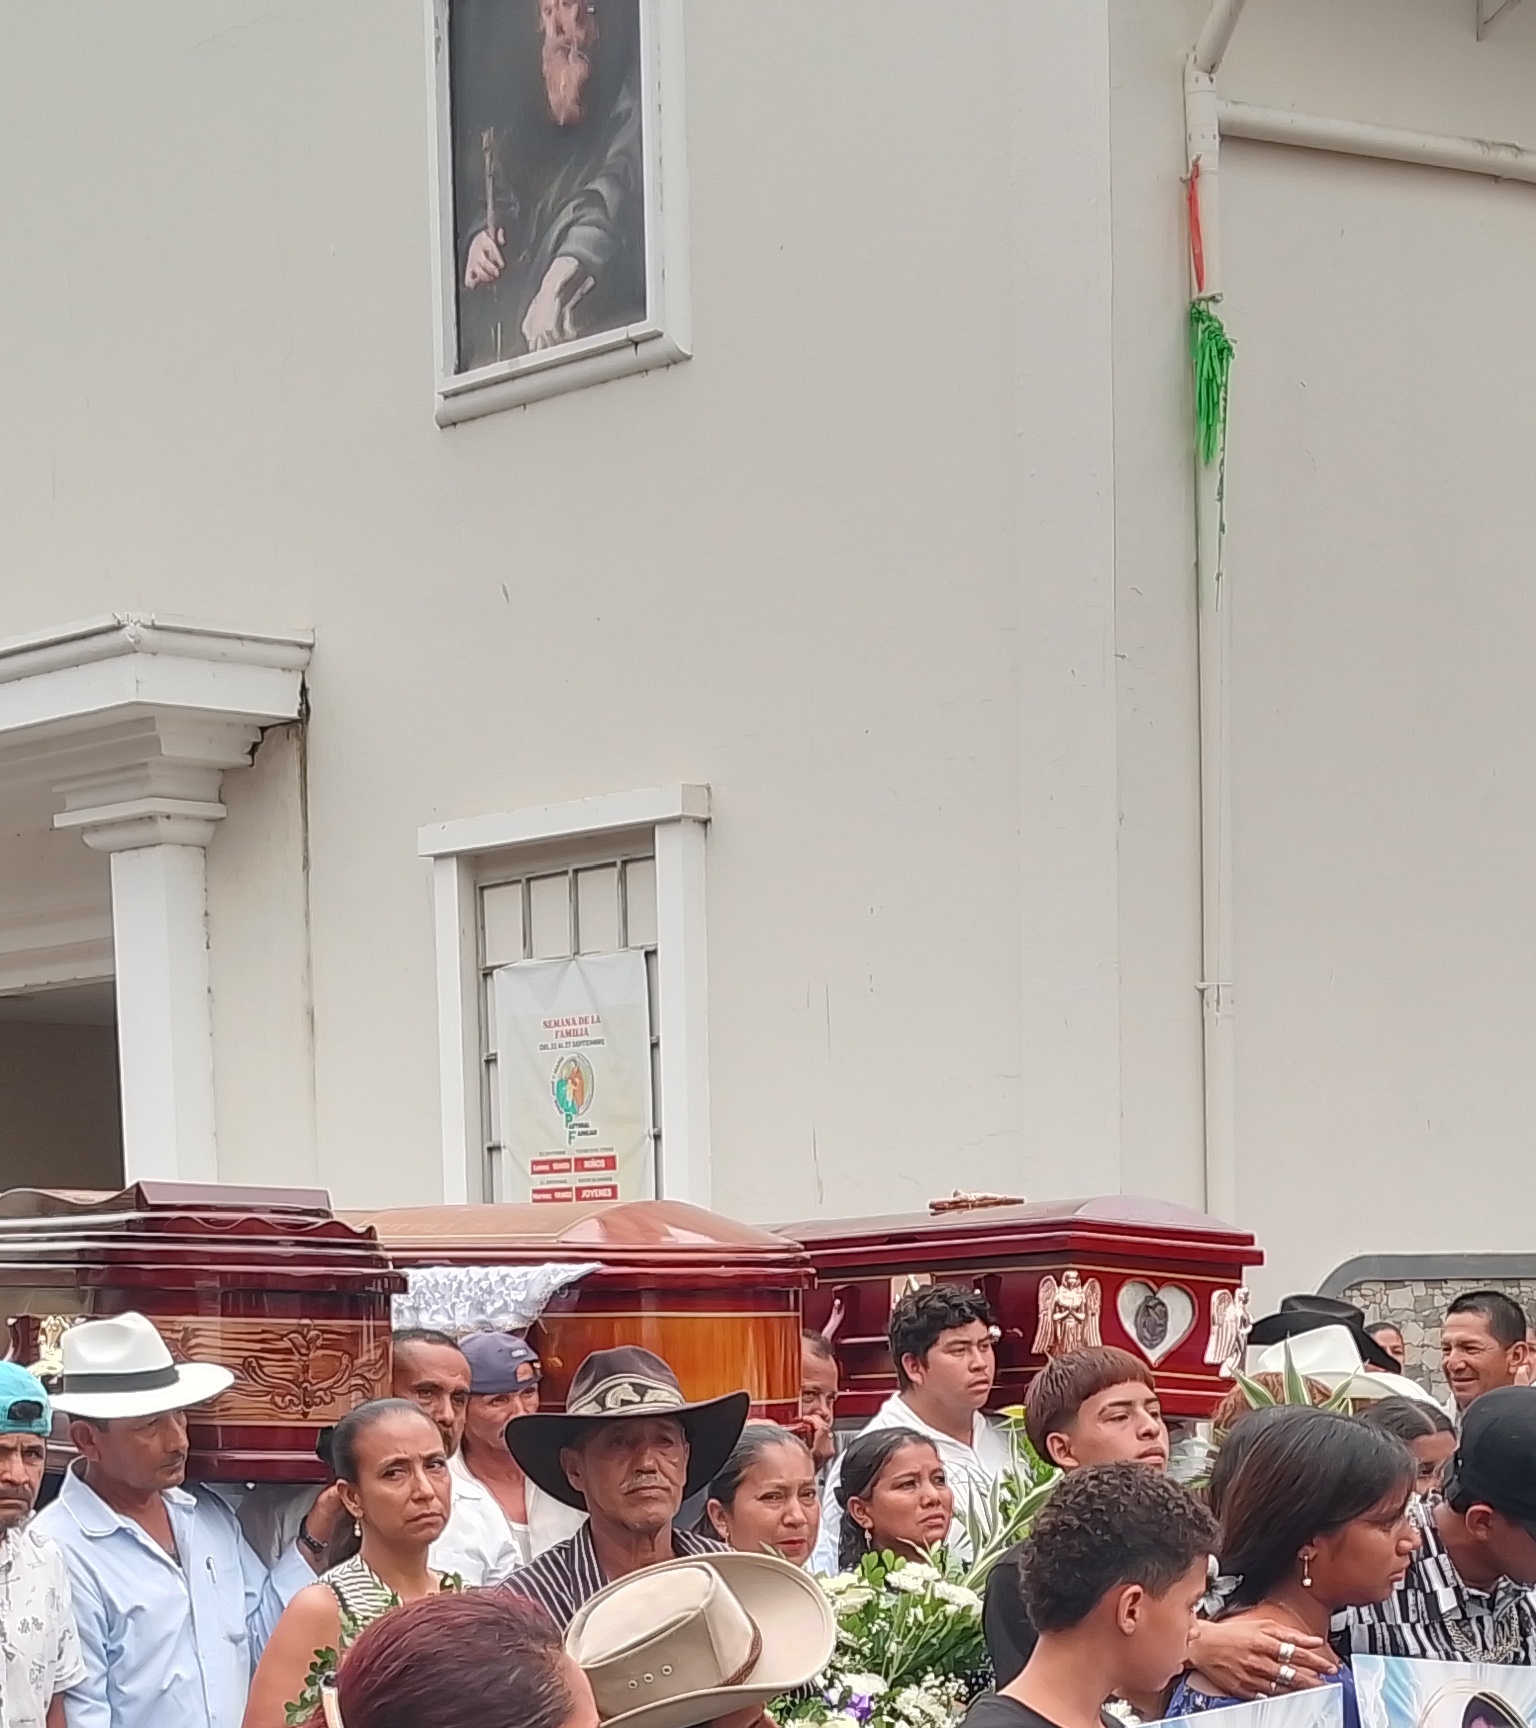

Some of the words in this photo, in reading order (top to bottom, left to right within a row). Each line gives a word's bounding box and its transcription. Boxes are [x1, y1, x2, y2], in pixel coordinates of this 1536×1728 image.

[543, 1016, 578, 1029] SEMANA
[578, 1015, 590, 1025] DE
[591, 1014, 602, 1025] LA
[555, 1026, 590, 1040] FAMILIA
